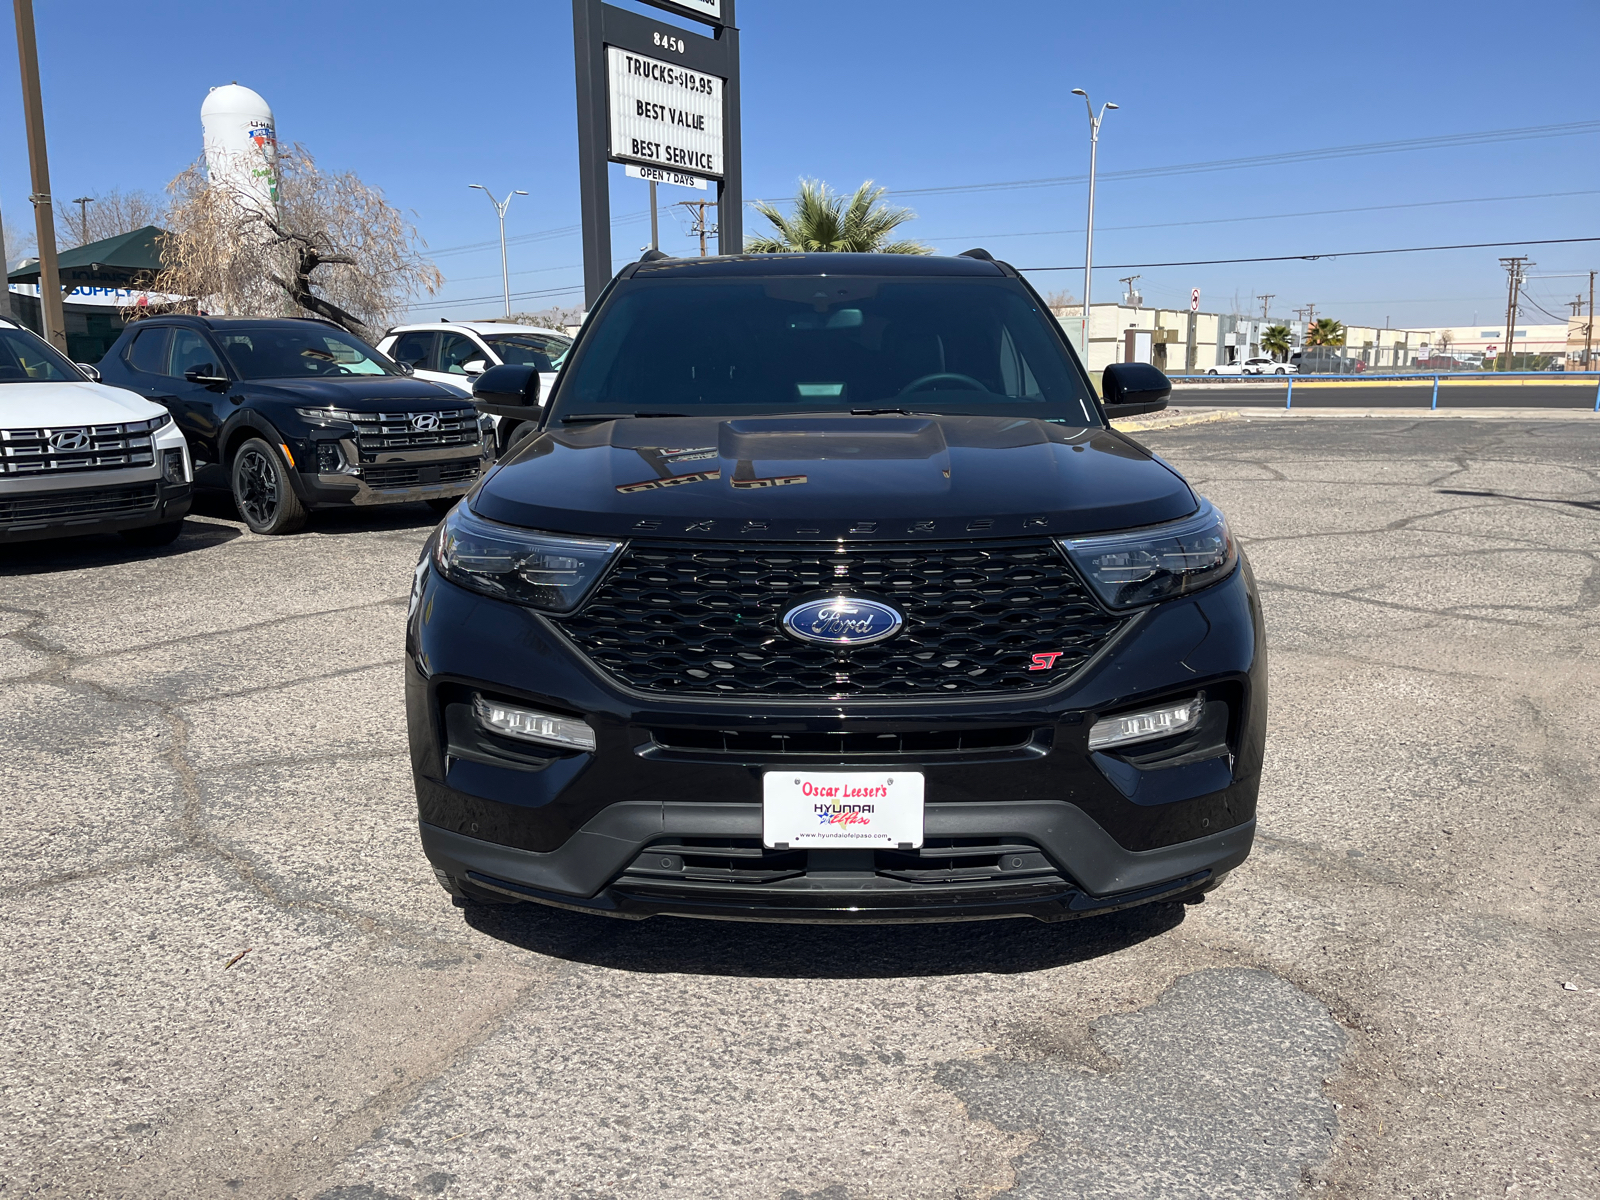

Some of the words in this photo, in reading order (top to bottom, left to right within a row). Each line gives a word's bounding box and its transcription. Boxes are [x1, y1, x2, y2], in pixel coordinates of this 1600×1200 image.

[653, 32, 685, 53] 8450
[636, 100, 665, 121] BEST
[669, 107, 704, 131] VALUE
[632, 138, 660, 159] BEST
[665, 145, 713, 170] SERVICE
[640, 167, 663, 181] OPEN
[666, 172, 671, 182] 7
[674, 174, 694, 186] DAYS
[811, 605, 874, 634] Ford
[1029, 651, 1063, 671] ST
[802, 781, 840, 798] Oscar
[843, 784, 887, 798] Leeser's
[814, 804, 874, 813] HYUNDAI
